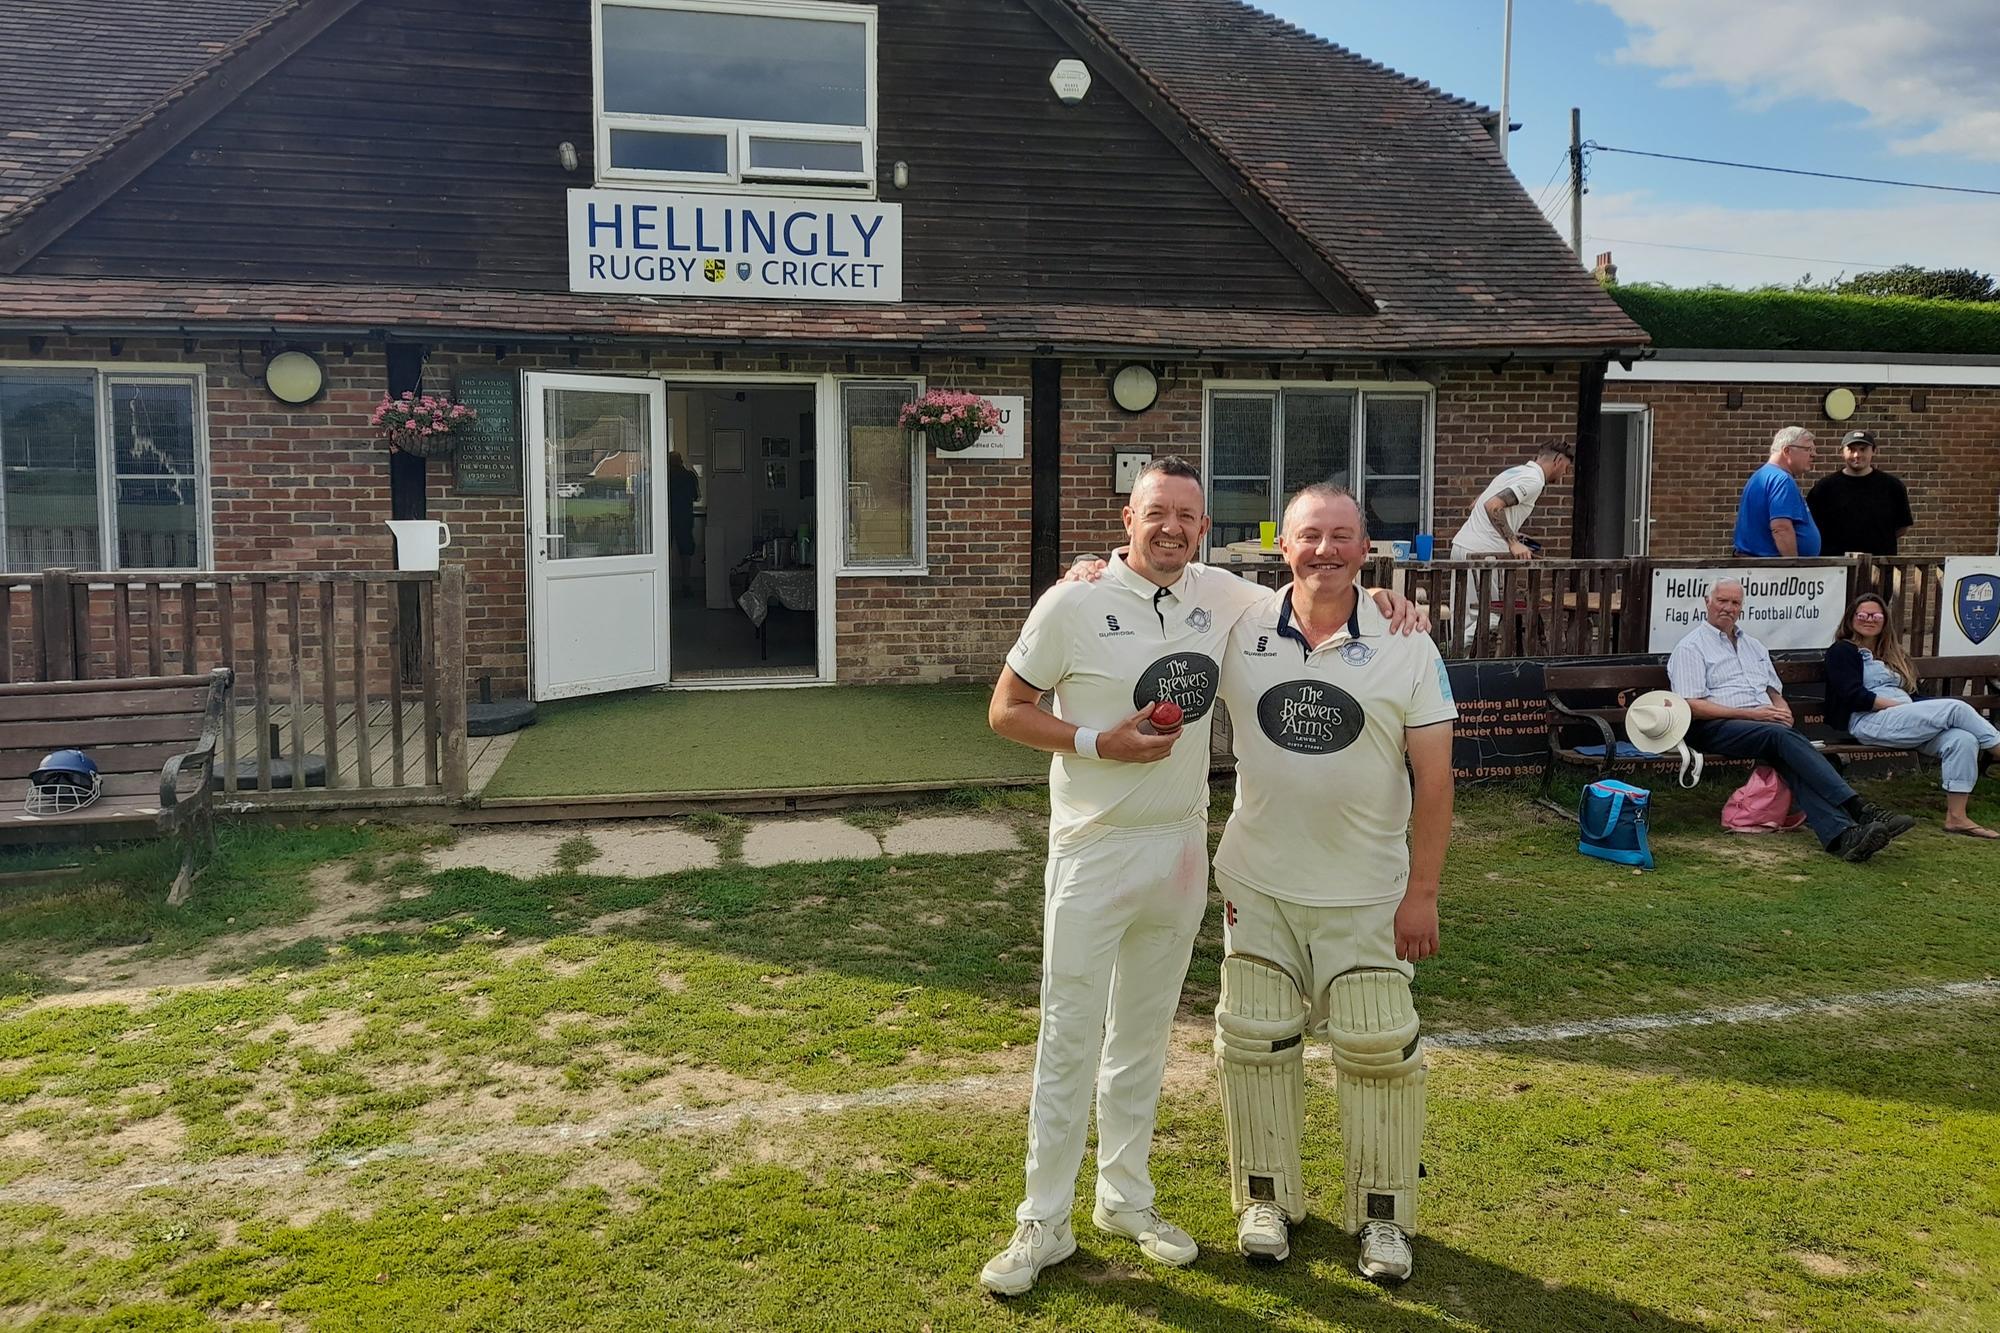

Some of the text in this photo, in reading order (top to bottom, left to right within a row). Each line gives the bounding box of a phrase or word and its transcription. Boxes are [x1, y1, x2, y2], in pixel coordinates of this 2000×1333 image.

[587, 203, 884, 258] HELLINGLY
[589, 254, 884, 288] RUGBY CRICKET
[1740, 576, 1825, 600] HoundDogs
[1665, 607, 1689, 625] Flag
[1749, 606, 1793, 621] Football
[1795, 605, 1820, 619] Club
[1166, 659, 1190, 678] The
[1157, 671, 1209, 699] Brewers
[1298, 685, 1324, 702] The
[1279, 698, 1343, 725] Brewers
[1456, 698, 1548, 710] roviding all your
[1279, 716, 1334, 742] Arms
[1454, 727, 1491, 737] atever
[1494, 726, 1513, 736] the
[1452, 768, 1473, 778] Tel.
[1475, 766, 1511, 777] 07590
